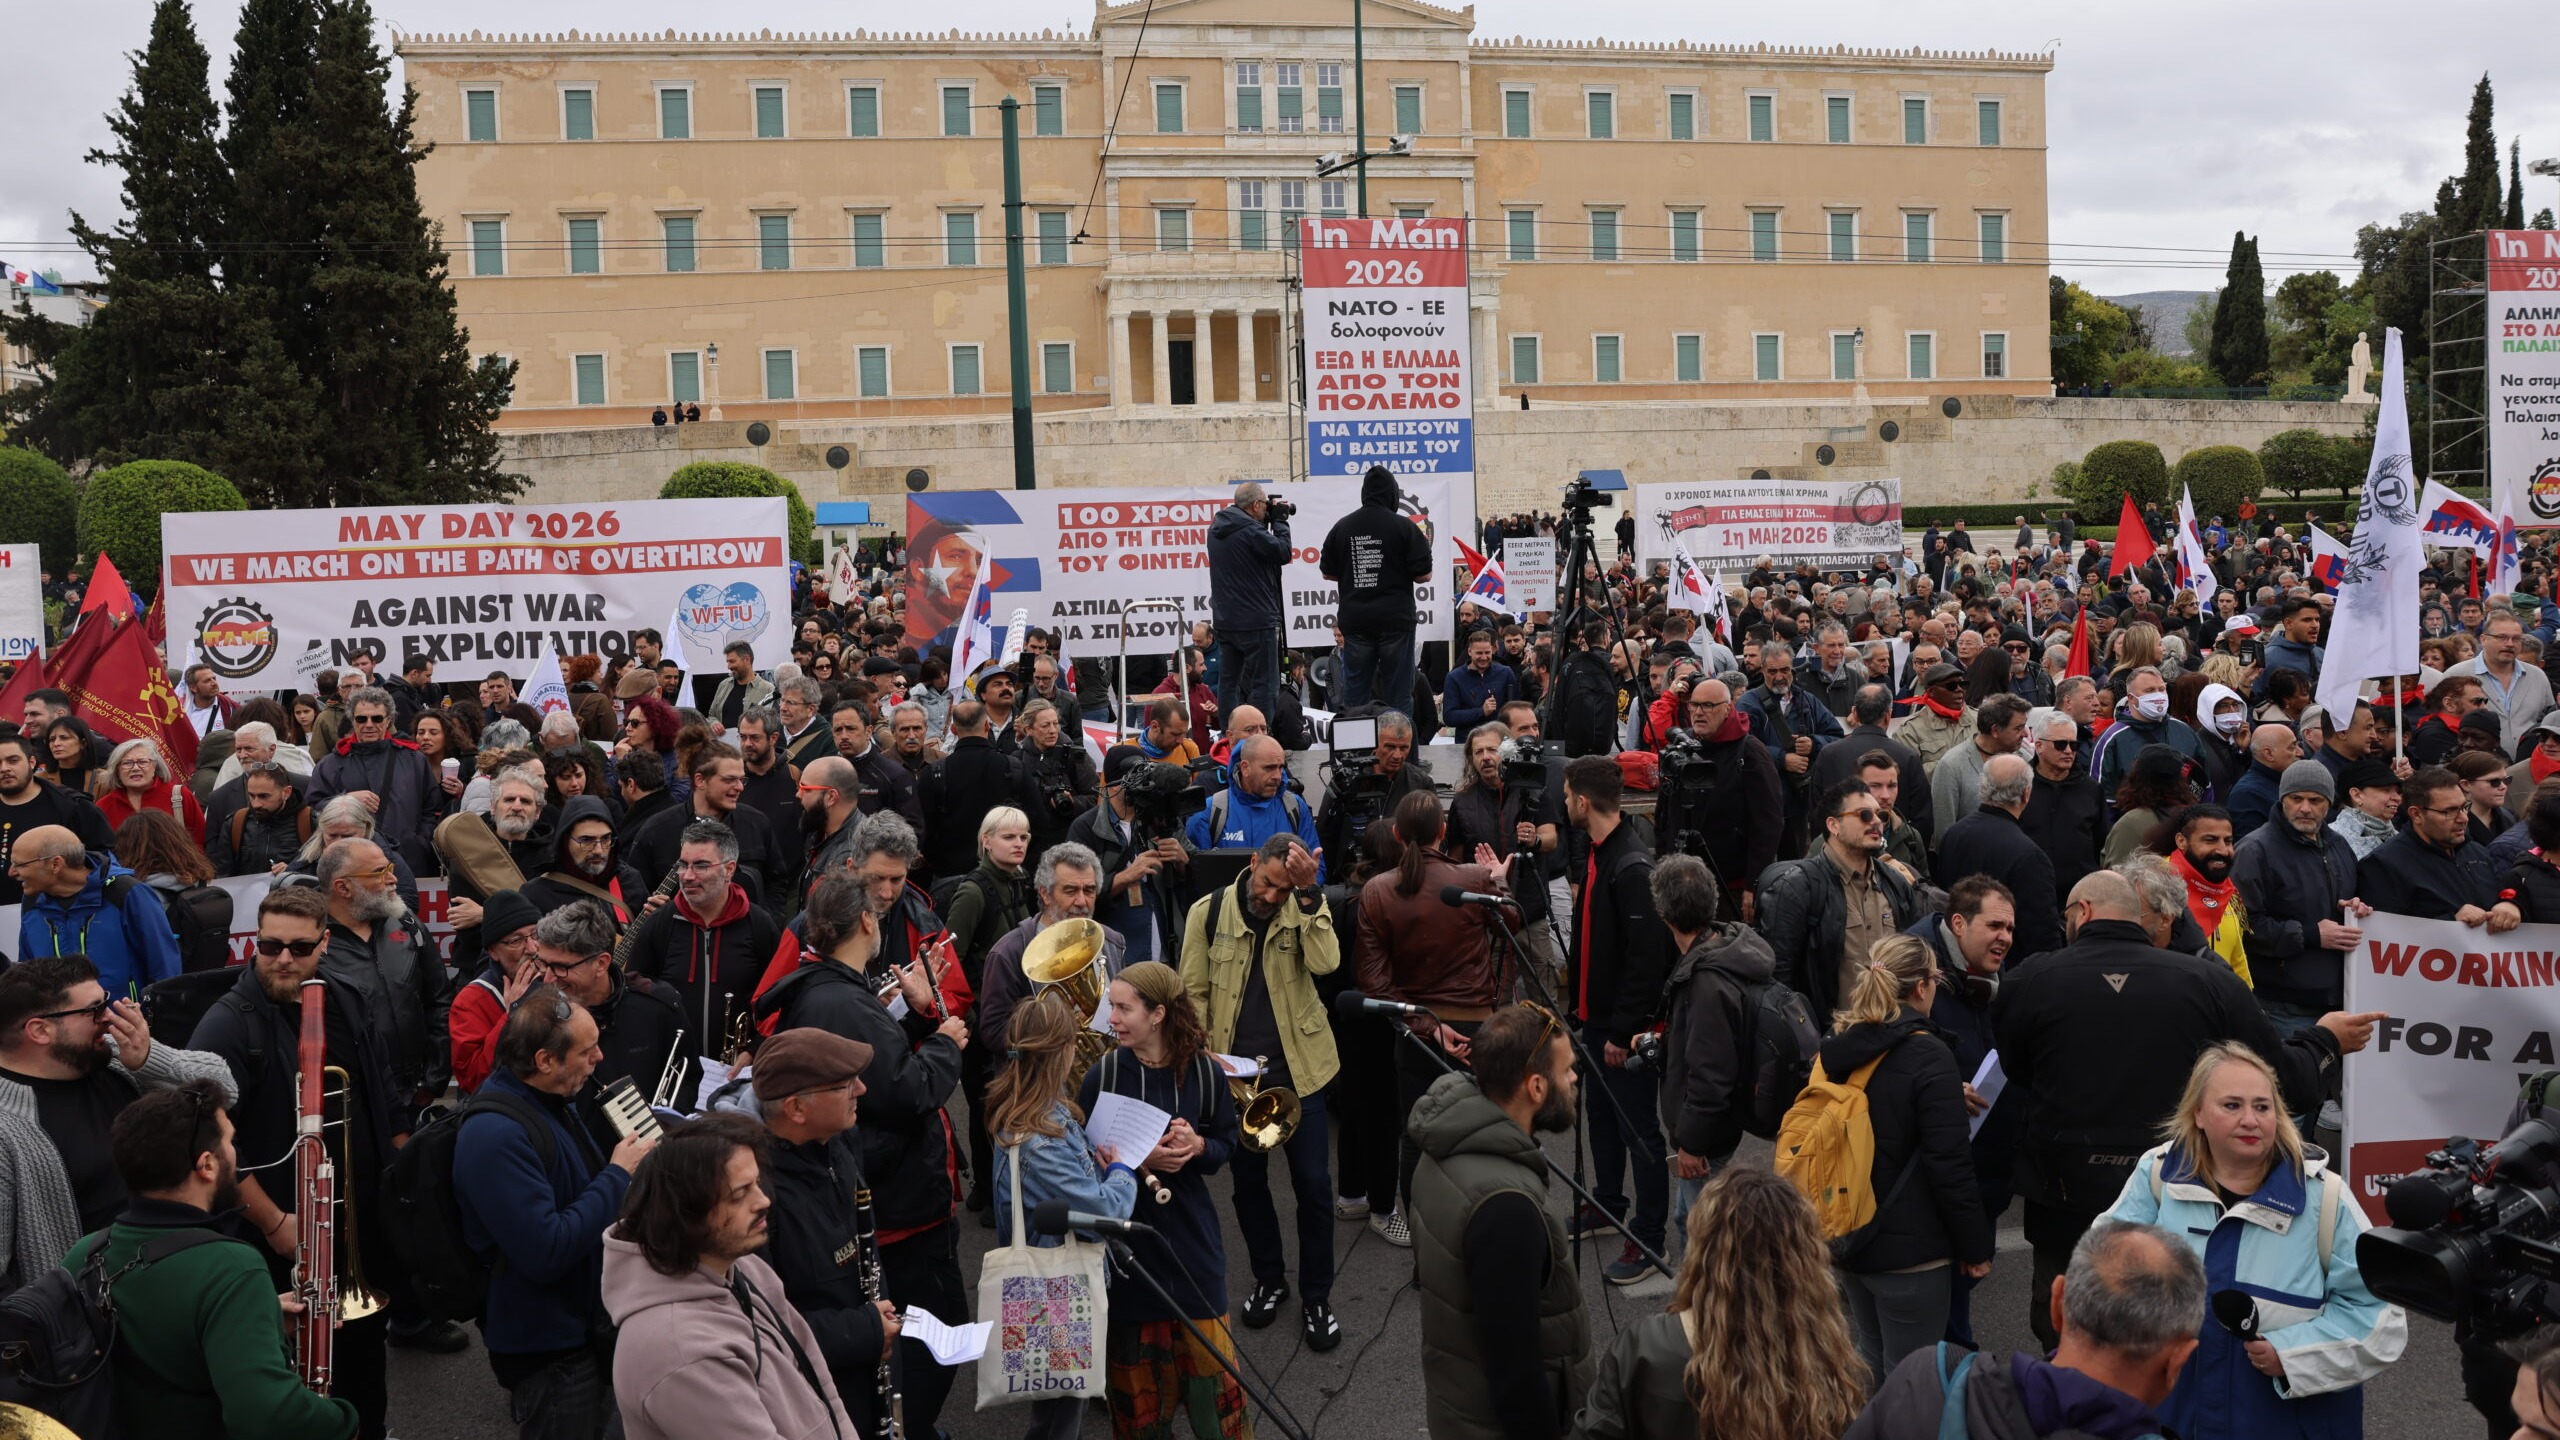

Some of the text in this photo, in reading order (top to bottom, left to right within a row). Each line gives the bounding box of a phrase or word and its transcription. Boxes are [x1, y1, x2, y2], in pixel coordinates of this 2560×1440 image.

[1345, 259, 1424, 285] 2026
[2526, 267, 2560, 289] 20
[1329, 300, 1398, 316] ΝΑΤΟ
[1423, 300, 1445, 315] ΕΕ
[1330, 321, 1445, 341] δολοφονούν
[2503, 324, 2537, 337] ΣΤΟ
[2503, 340, 2560, 352] ΠΑΛΑΙ
[1315, 349, 1460, 369] ΕΞΩ Η ΕΛΛΑΔΑ
[1317, 373, 1460, 390] ΑΠΟ ΤΟΝ
[2501, 374, 2523, 387] Να
[1318, 392, 1460, 411] ΠΟΛΕΜΟ
[1321, 421, 1459, 437] ΝΑ ΚΛΕΙΣΟΥΝ
[1320, 440, 1460, 456] ΟΙ ΒΑΣΕΙΣ ΤΟΥ
[1665, 492, 1671, 500] Ο
[1674, 490, 1711, 500] ΧΡΟΝΟΣ
[1714, 489, 1732, 498] ΜΑΣ
[1734, 489, 1746, 498] ΓΙΑ
[1748, 488, 1774, 497] ΑΥΤΟΥΣ
[1796, 489, 1828, 498] ΧΡΗΜΑ
[1061, 506, 1120, 526] 100
[1721, 509, 1738, 520] ΓΙΑ
[1740, 509, 1764, 519] ΕΜΑΣ
[1786, 509, 1794, 518] Η
[338, 510, 620, 543] MAY DAY 2026
[1058, 529, 1209, 549] ΑΠΟ ΤΗ ΓΕΝΝ
[1722, 526, 1828, 550] 1η ΜΑΗ 2026
[190, 541, 765, 581] WE MARCH ON THE PATH OF OVERTHROW
[1058, 552, 1210, 573] ΤΟΥ ΦΙΝΤΕΛ
[1729, 558, 1744, 568] ΓΙΑ
[1820, 555, 1867, 565] ΠΟΛΕΜΟΥΣ
[1052, 598, 1138, 617] ΑΣΠΙΔΑ
[1291, 589, 1340, 607] ΕΙΝΑ
[350, 593, 607, 629] AGAINST WAR
[691, 604, 754, 625] WFTU
[1091, 621, 1193, 639] ΣΠΑΣΟΥΝ
[1293, 613, 1338, 631] ΑΠΟ
[111, 716, 151, 742] ΞΕΝΟΔΟΧ
[2368, 939, 2560, 987] WORKIN
[2378, 1017, 2555, 1064] FOR A
[1007, 1371, 1086, 1394] Lisboa
